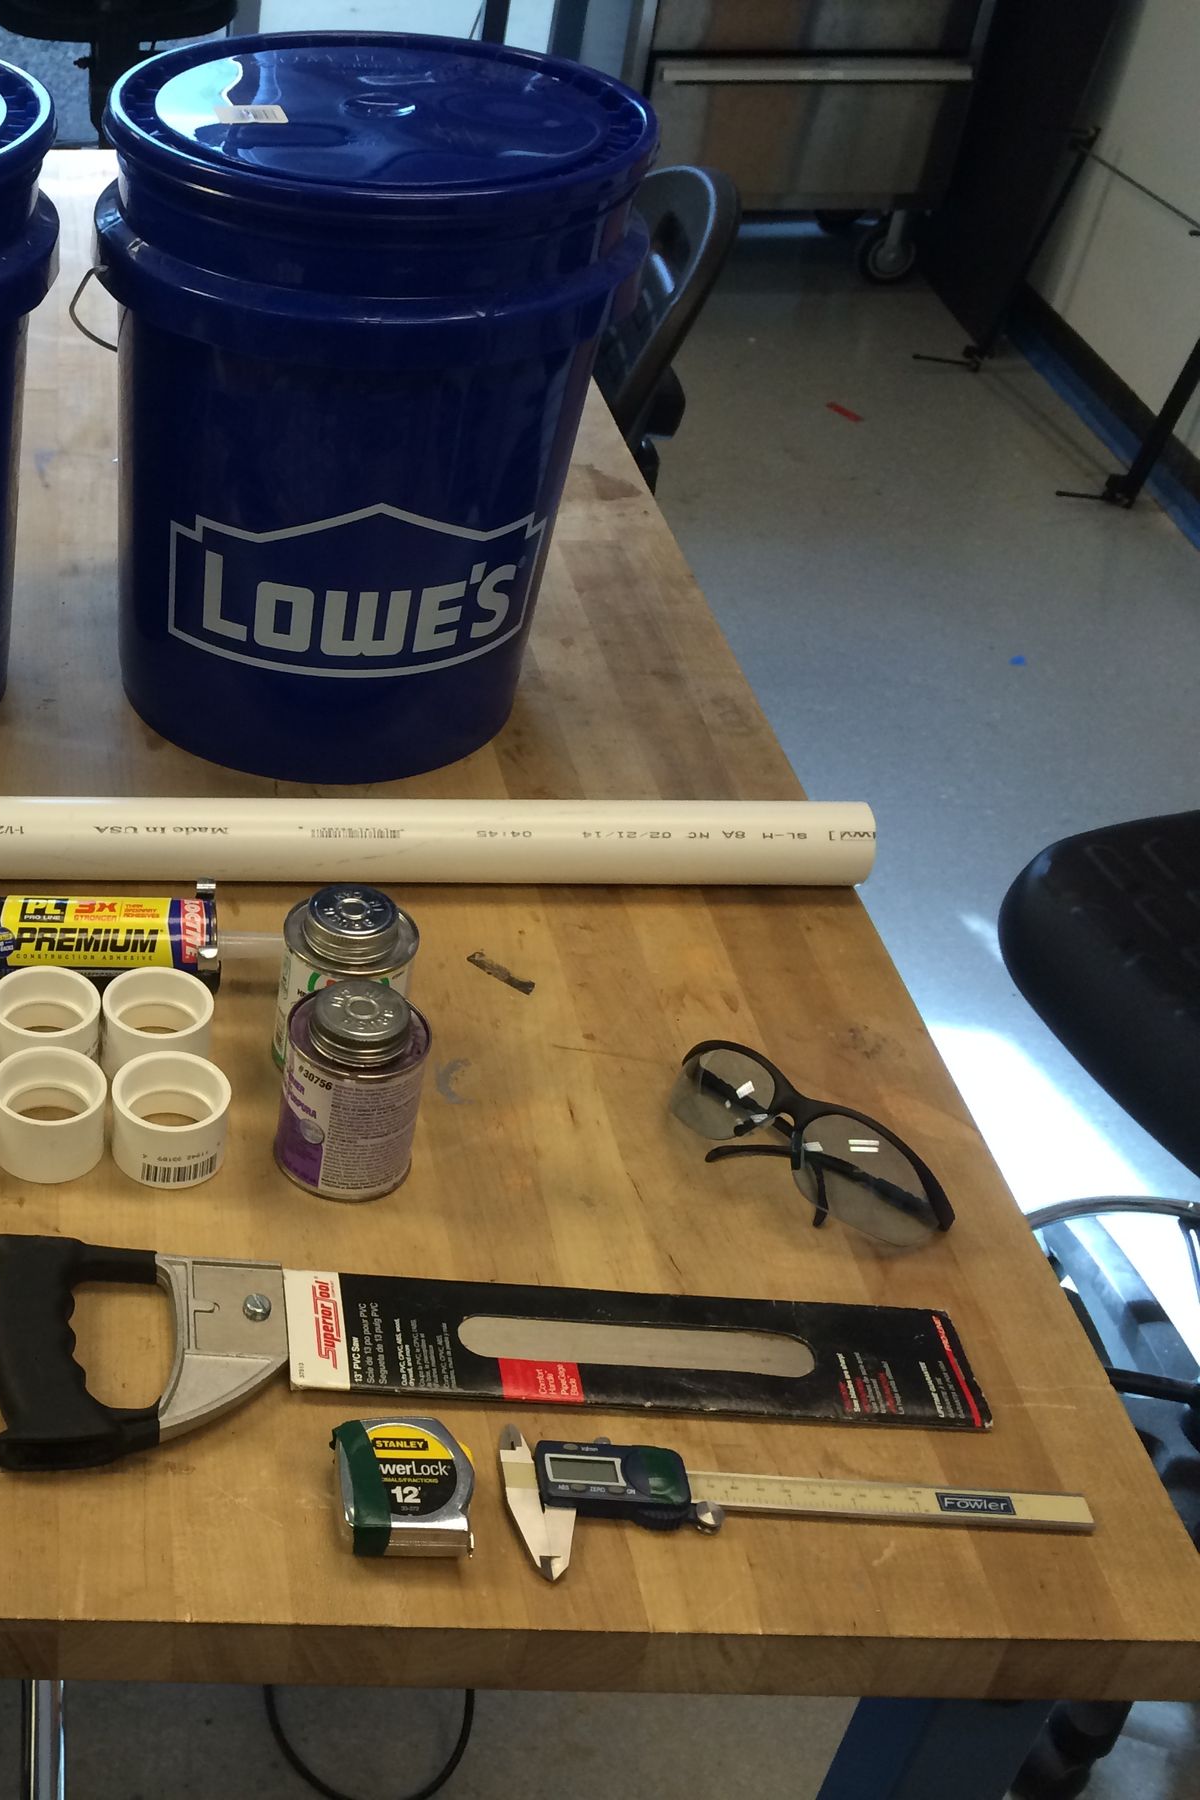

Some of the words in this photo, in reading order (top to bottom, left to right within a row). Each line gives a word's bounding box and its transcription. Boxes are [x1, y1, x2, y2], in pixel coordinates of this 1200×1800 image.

[203, 550, 516, 656] LOWE'S
[93, 825, 140, 834] USA
[171, 825, 228, 835] Made
[26, 899, 63, 914] PL
[16, 927, 159, 953] PREMIUM
[358, 1303, 367, 1318] PVC
[370, 1302, 379, 1317] PVC
[352, 1336, 360, 1352] Saw
[364, 1335, 373, 1345] po
[374, 1334, 383, 1342] 13
[376, 1344, 384, 1353] de
[352, 1353, 362, 1370] PVC
[366, 1356, 373, 1366] de
[366, 1367, 375, 1384] Scie
[375, 1440, 425, 1448] STANLEY
[380, 1461, 449, 1476] werLock
[943, 1497, 1008, 1511] Fowler
